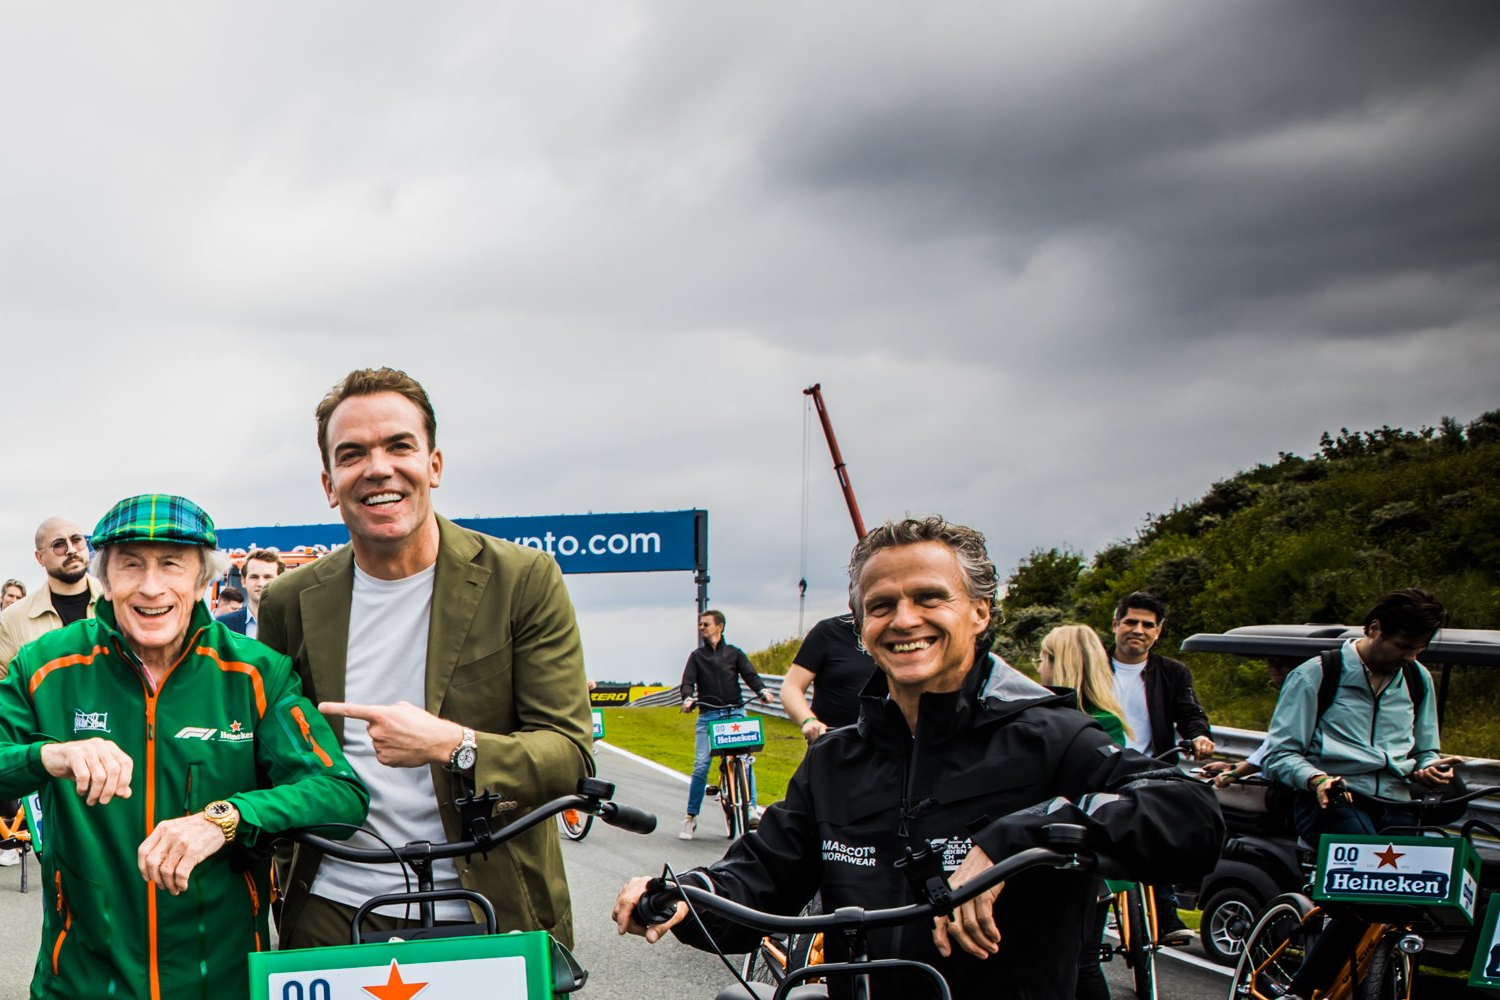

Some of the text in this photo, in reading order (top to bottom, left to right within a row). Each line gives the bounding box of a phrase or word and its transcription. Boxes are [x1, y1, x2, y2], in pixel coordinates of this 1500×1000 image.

[591, 693, 627, 701] ZERO
[822, 852, 876, 866] WORKWEAR
[1334, 847, 1359, 862] 0.0
